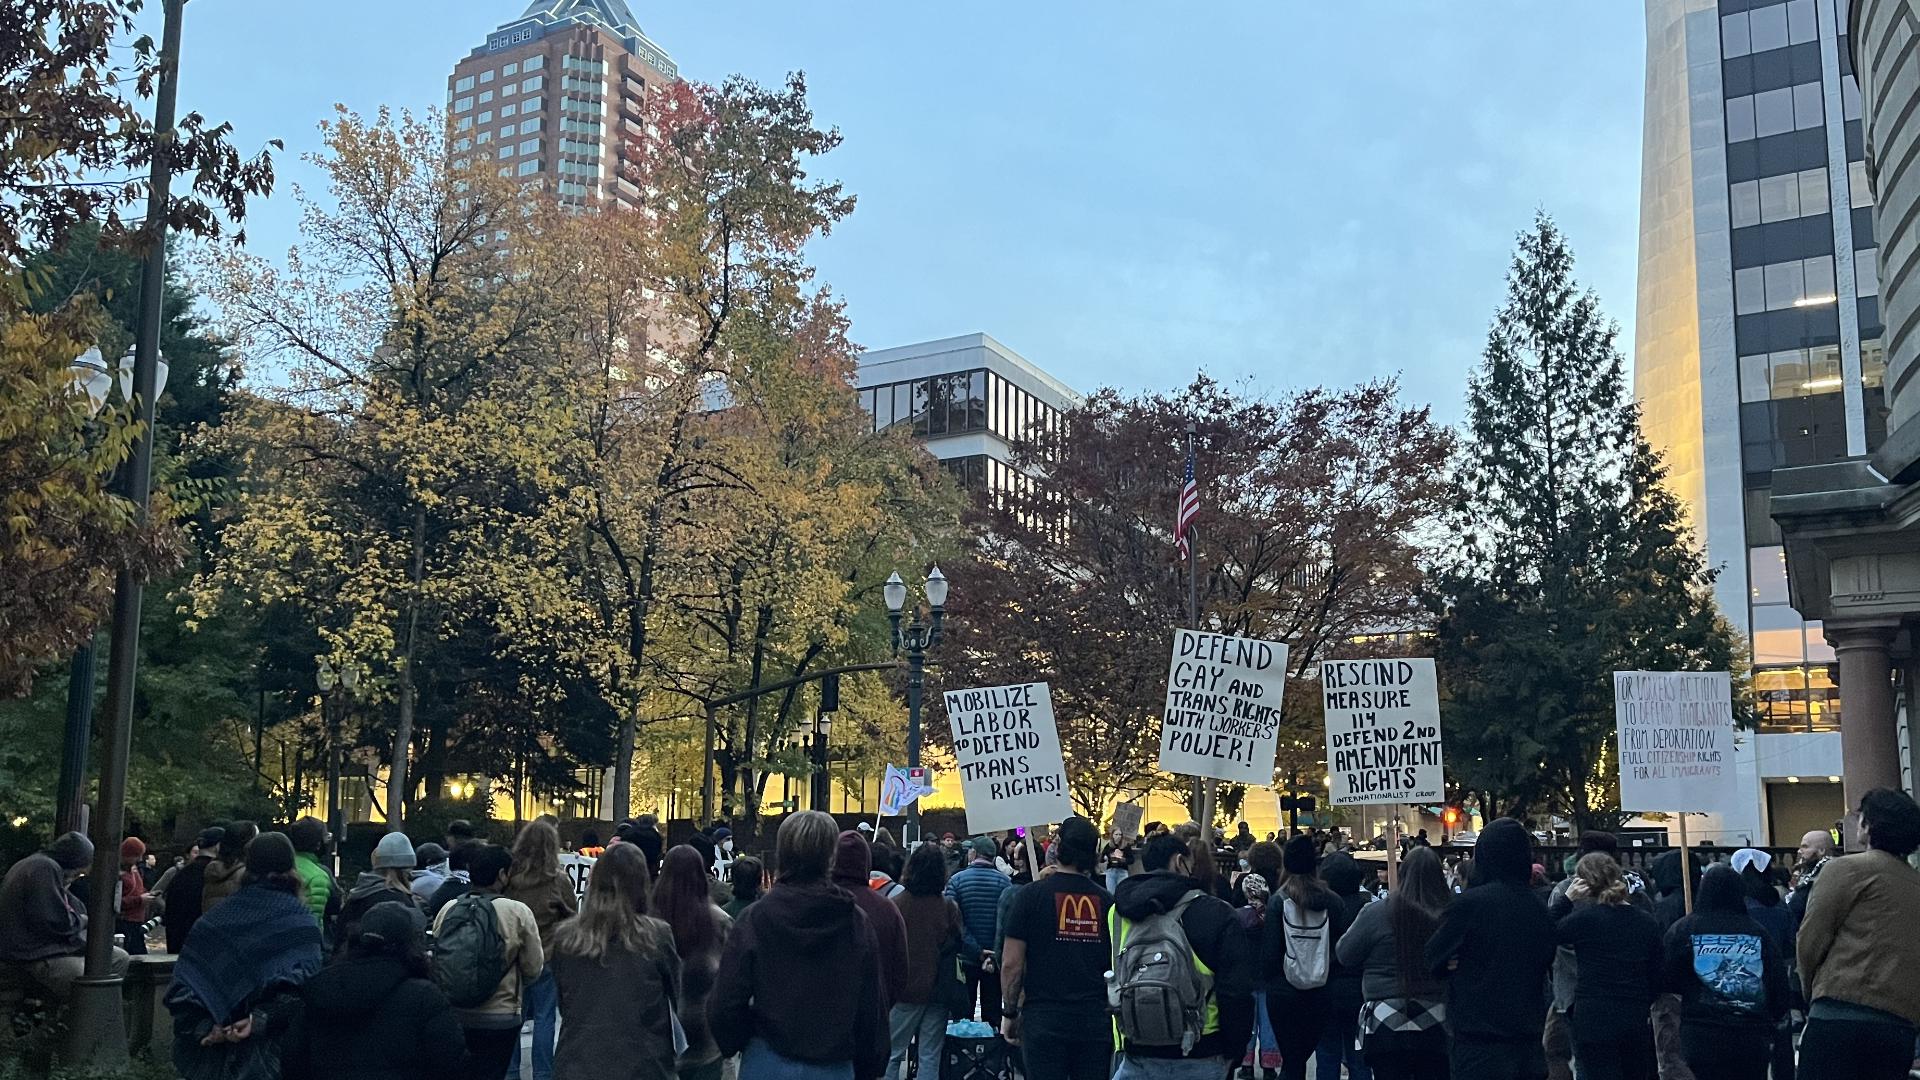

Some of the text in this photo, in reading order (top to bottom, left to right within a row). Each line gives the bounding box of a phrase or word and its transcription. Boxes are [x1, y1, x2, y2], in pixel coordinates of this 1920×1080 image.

[1180, 633, 1272, 670] DEFEND
[1174, 662, 1264, 698] GAY AND
[1325, 661, 1413, 688] RESCIND
[947, 685, 1037, 713] MOBILIZE
[1327, 690, 1411, 709] MEASURE
[1616, 676, 1634, 701] FOR
[1680, 677, 1719, 701] ACTION
[958, 709, 1032, 735] LABOR
[1171, 691, 1280, 727] TRANS RIGHTS
[1352, 712, 1376, 729] 114
[1624, 702, 1637, 726] TO
[1640, 701, 1674, 726] DEFEND
[1166, 709, 1275, 740] WITH WORKERS
[1333, 721, 1436, 748] DEFEND 2ND
[955, 732, 1040, 755] TO DEFEND
[1169, 730, 1254, 767] POWER!
[1624, 728, 1716, 750] FROM DEPORTATION
[961, 756, 1029, 781] TRANS
[1335, 741, 1441, 772] AMENDMENT
[1622, 751, 1722, 765] FULL CITIZENSHIP RIGHTS
[1348, 767, 1416, 793] RIGHTS
[1633, 766, 1650, 780] FOR
[1652, 766, 1667, 779] ALL
[990, 774, 1061, 800] RIGHTS!
[1336, 791, 1410, 803] INTERNATIONALIST
